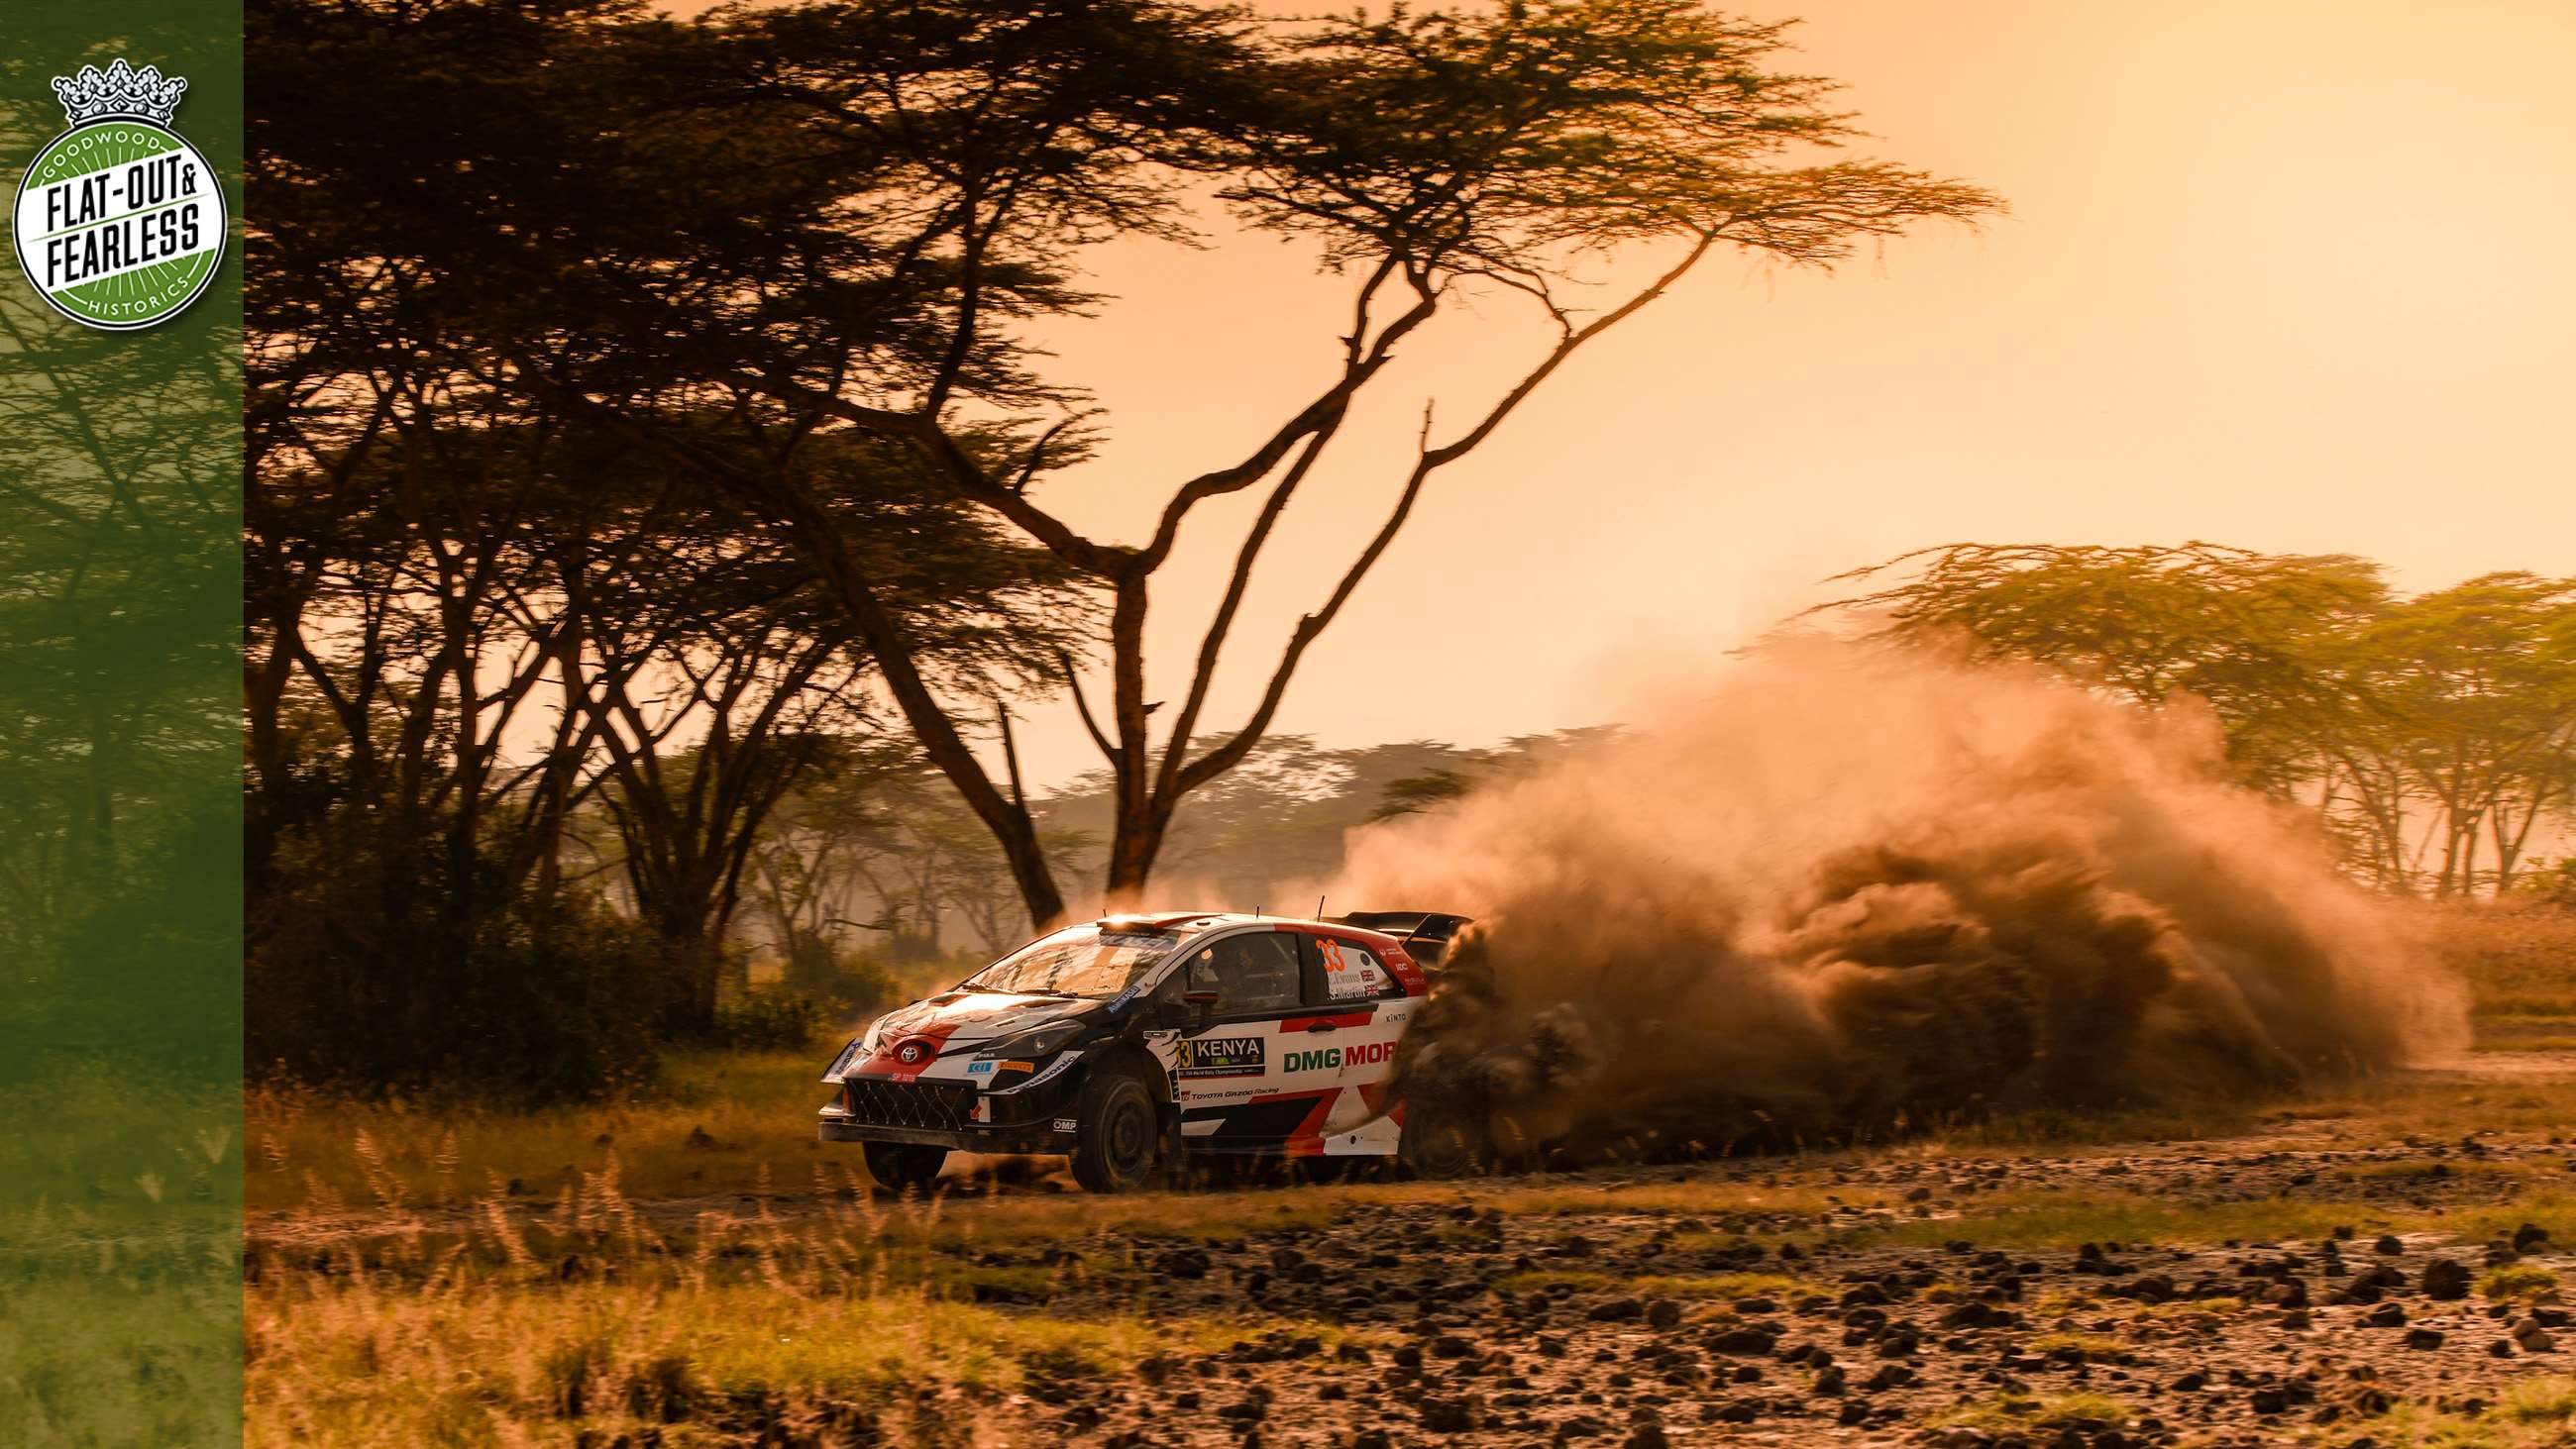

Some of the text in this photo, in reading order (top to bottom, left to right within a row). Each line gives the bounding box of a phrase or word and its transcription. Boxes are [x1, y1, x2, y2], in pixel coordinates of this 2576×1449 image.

[1316, 938, 1346, 973] 33
[1197, 1038, 1260, 1058] KENYA
[1283, 1048, 1342, 1073] DMG
[1053, 1120, 1077, 1129] OMP
